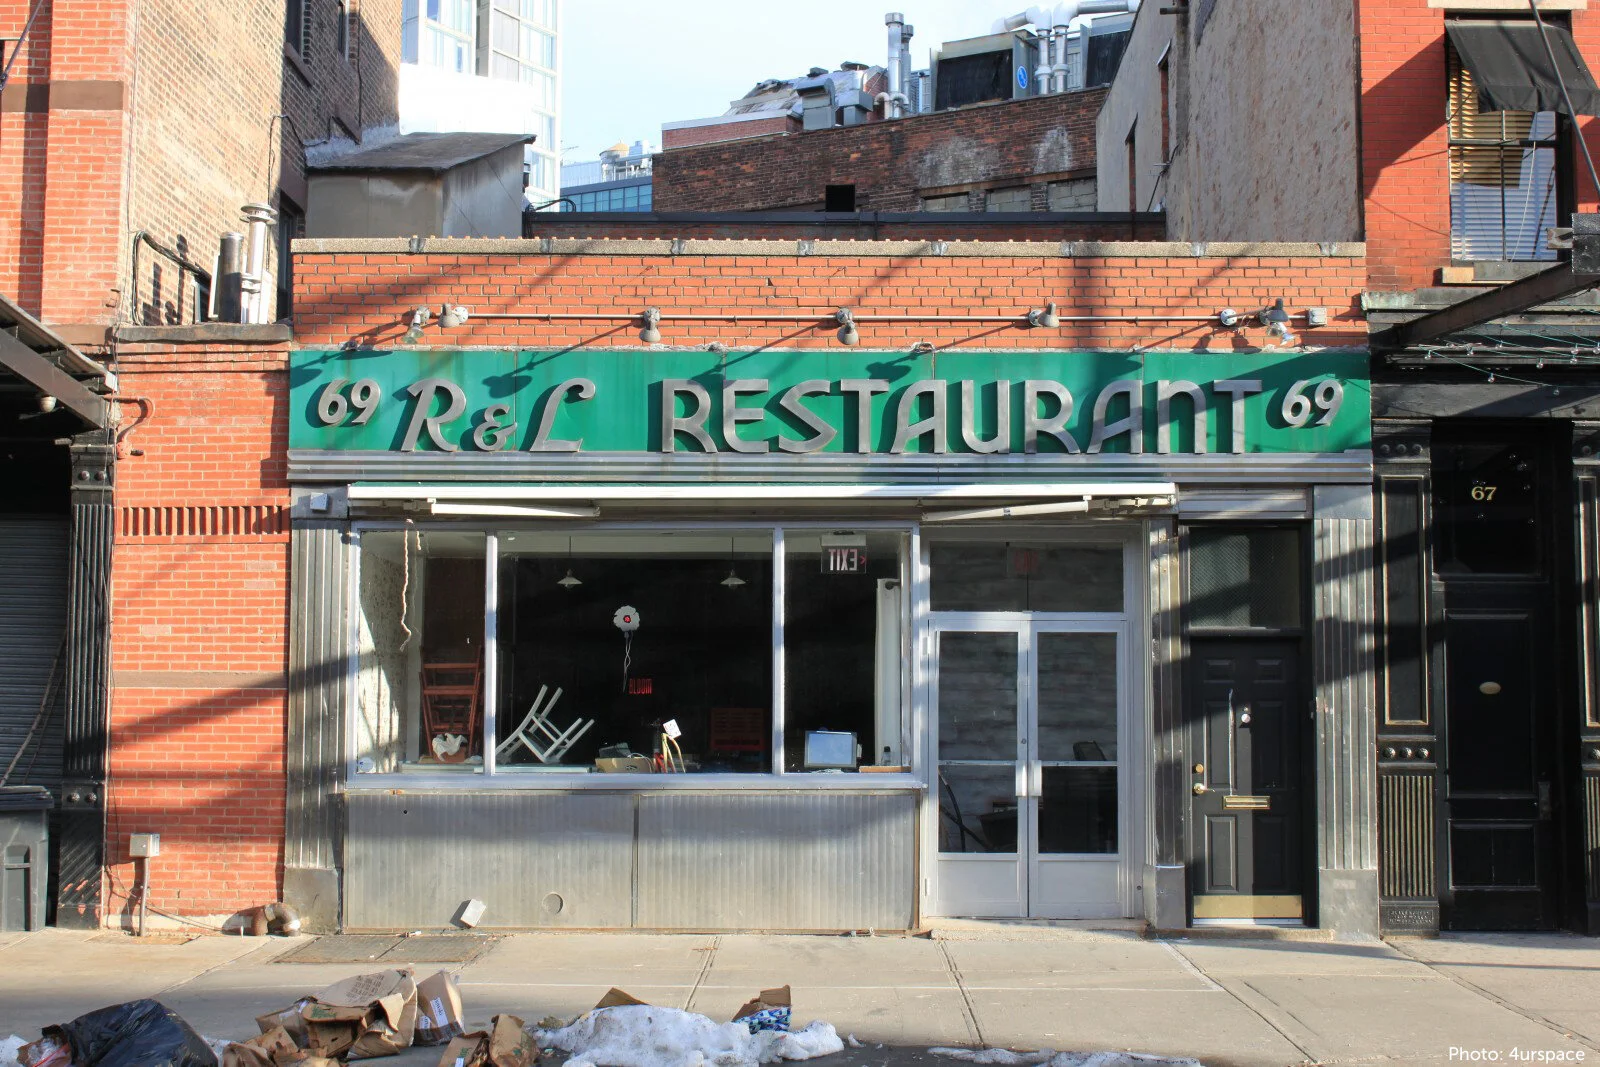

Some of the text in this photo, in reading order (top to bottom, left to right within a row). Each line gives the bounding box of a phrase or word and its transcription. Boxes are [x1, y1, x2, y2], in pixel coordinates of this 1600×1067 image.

[318, 379, 381, 427] 69
[662, 379, 1262, 454] RESTAURANT
[1282, 380, 1344, 428] 69
[1471, 486, 1497, 500] 67
